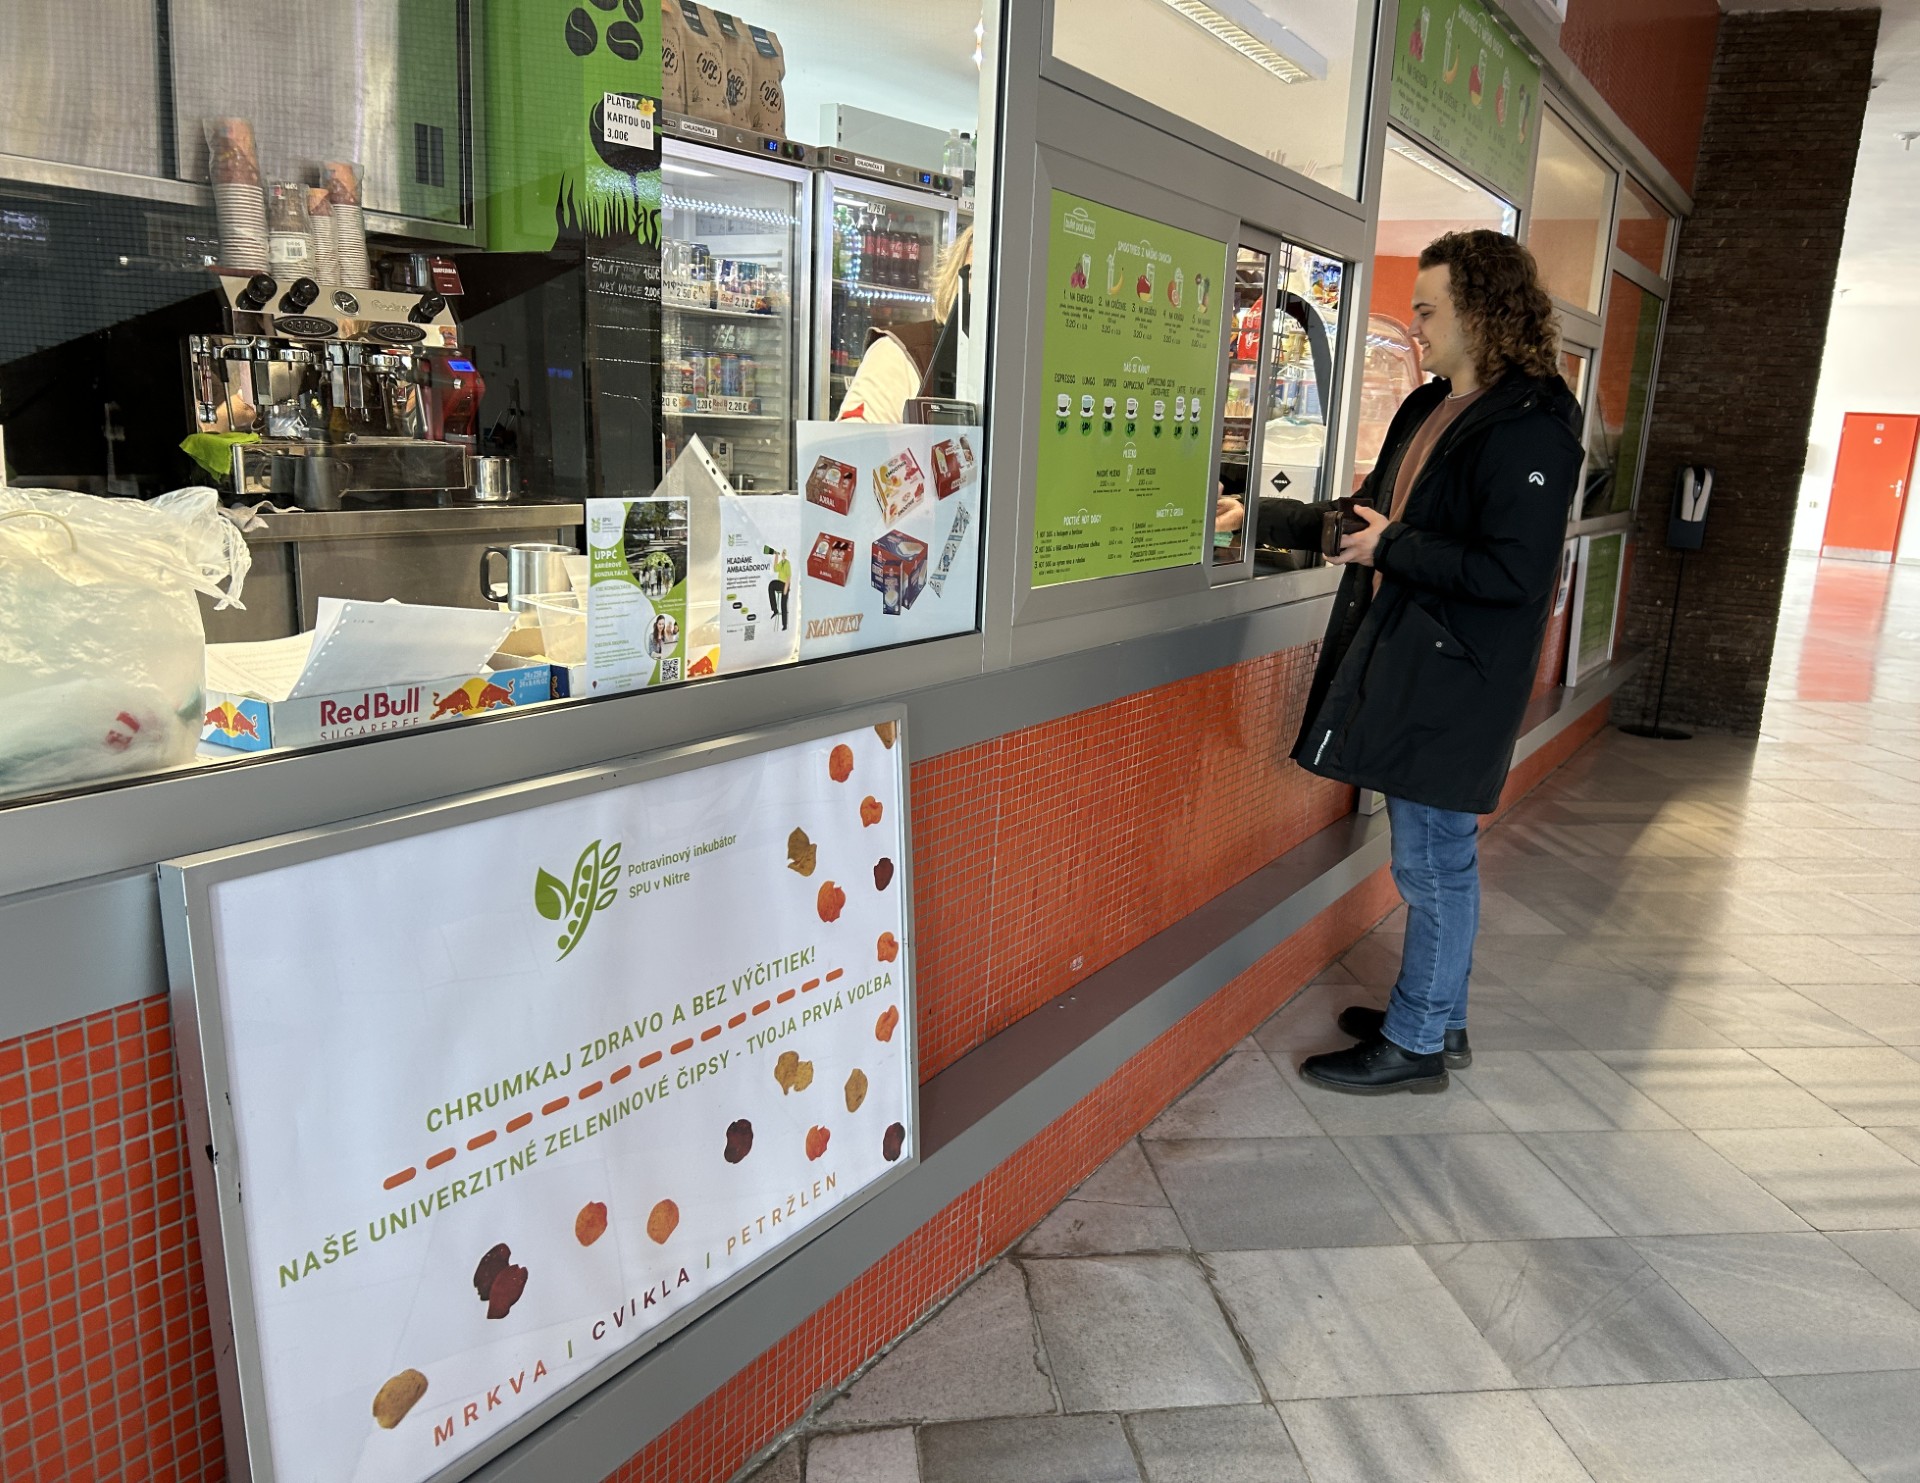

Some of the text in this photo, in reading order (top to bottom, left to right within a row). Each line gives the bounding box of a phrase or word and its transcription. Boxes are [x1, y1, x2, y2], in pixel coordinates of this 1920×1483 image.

[606, 94, 638, 110] PLATBA
[607, 111, 639, 127] KARTOU
[640, 119, 651, 130] OD
[607, 128, 629, 141] 3,00€
[1054, 372, 1076, 384] ESPRESSO
[1082, 376, 1096, 386] LUNGO
[1123, 380, 1145, 391] CAPPUCCINO
[594, 548, 617, 560] UPPČ
[726, 554, 752, 565] HĽADÁME
[805, 613, 864, 639] NANUKY
[320, 686, 420, 727] Red Bull
[628, 833, 737, 877] Potravinový inkubátor
[629, 870, 691, 899] SPU v Nitre
[426, 945, 816, 1132] CHRUMKAJ ZDRAVO A BEZ VÝČITIEK!
[278, 1229, 359, 1288] NAŠE
[369, 1139, 537, 1243] UNIVERZITNÉ
[544, 1069, 670, 1156] ZELENINOVÉ
[677, 1050, 730, 1090] ČIPSY
[746, 1016, 798, 1055] TVOJA
[802, 991, 844, 1027] PRVÁ
[847, 972, 893, 1004] VOĽBA
[432, 1360, 548, 1447] MRKVA
[591, 1267, 691, 1341] CVIKLA
[727, 1172, 838, 1256] PETRŽLEN
